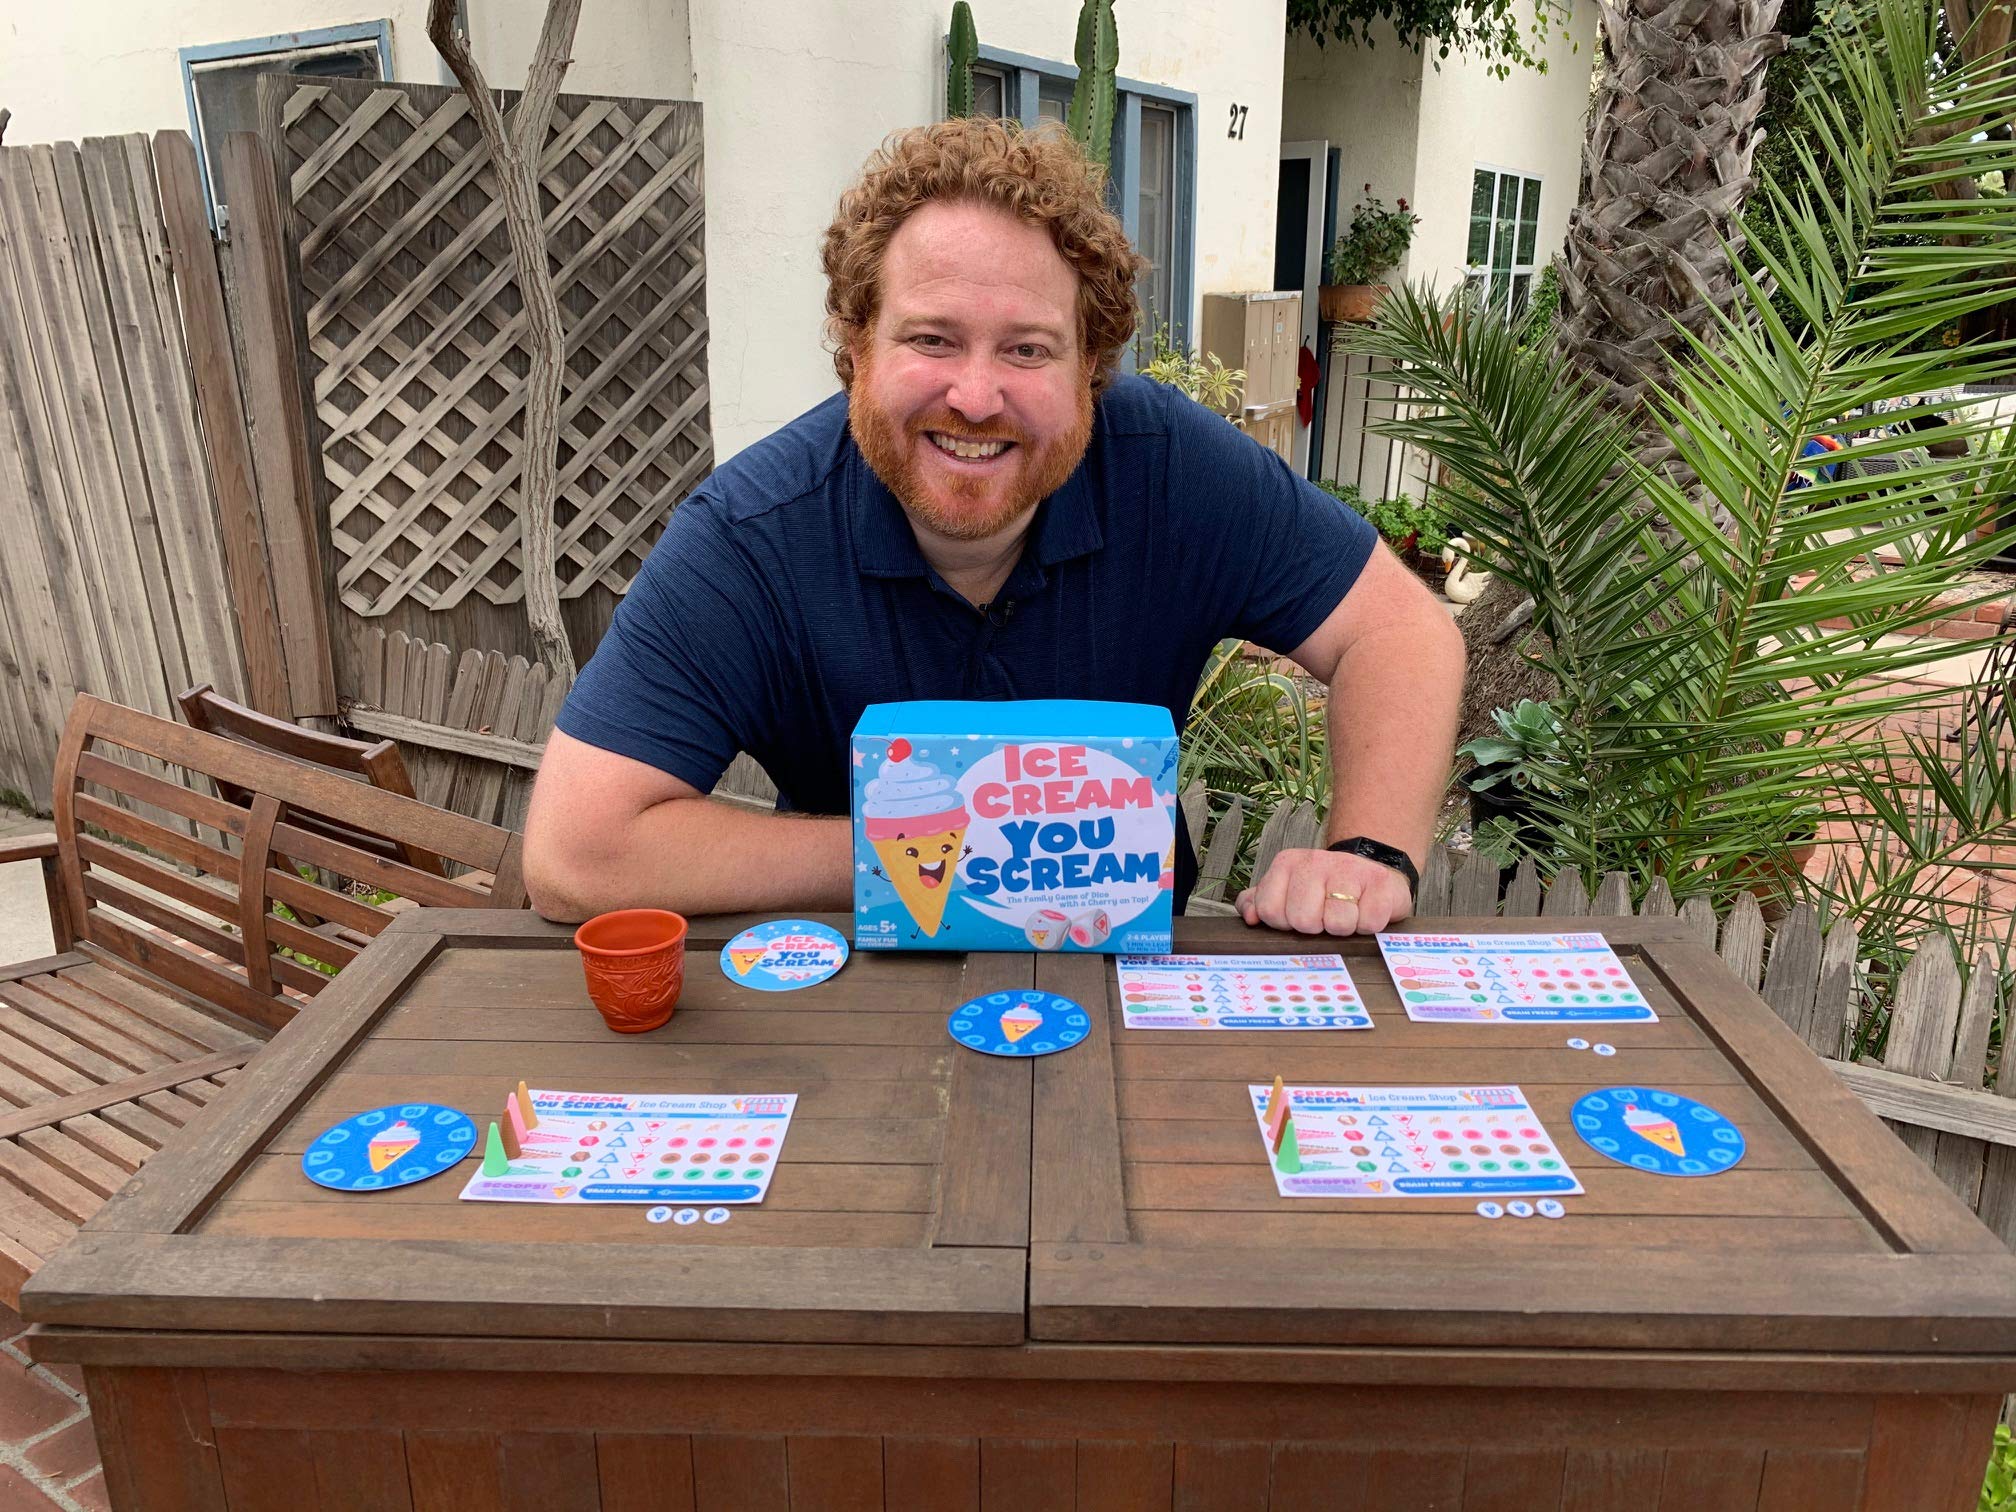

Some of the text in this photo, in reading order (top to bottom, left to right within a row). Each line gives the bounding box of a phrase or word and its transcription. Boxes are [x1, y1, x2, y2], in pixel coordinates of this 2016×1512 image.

[1228, 102, 1248, 140] 27
[1004, 745, 1088, 782] ICE
[972, 777, 1153, 819] CREAM
[999, 816, 1115, 858] YOU
[966, 852, 1160, 896] SCREAM
[1007, 896, 1022, 904] The
[1024, 895, 1053, 903] Family
[1055, 893, 1078, 901] Game
[1060, 900, 1078, 908] with
[1088, 898, 1118, 906] Cherry
[1132, 895, 1149, 903] Top!
[880, 920, 897, 933] 5+
[785, 935, 815, 943] ICE
[1528, 939, 1551, 947] Shop
[770, 942, 836, 950] CREAM
[778, 951, 820, 961] YOU
[760, 958, 835, 967] SCREAM
[538, 1093, 624, 1102] ICE CREAM
[1293, 1095, 1359, 1104] SCREAM
[1429, 1093, 1456, 1103] Shop
[561, 1101, 628, 1109] SCREAM
[660, 1101, 695, 1109] Cream
[699, 1101, 727, 1110] Shop
